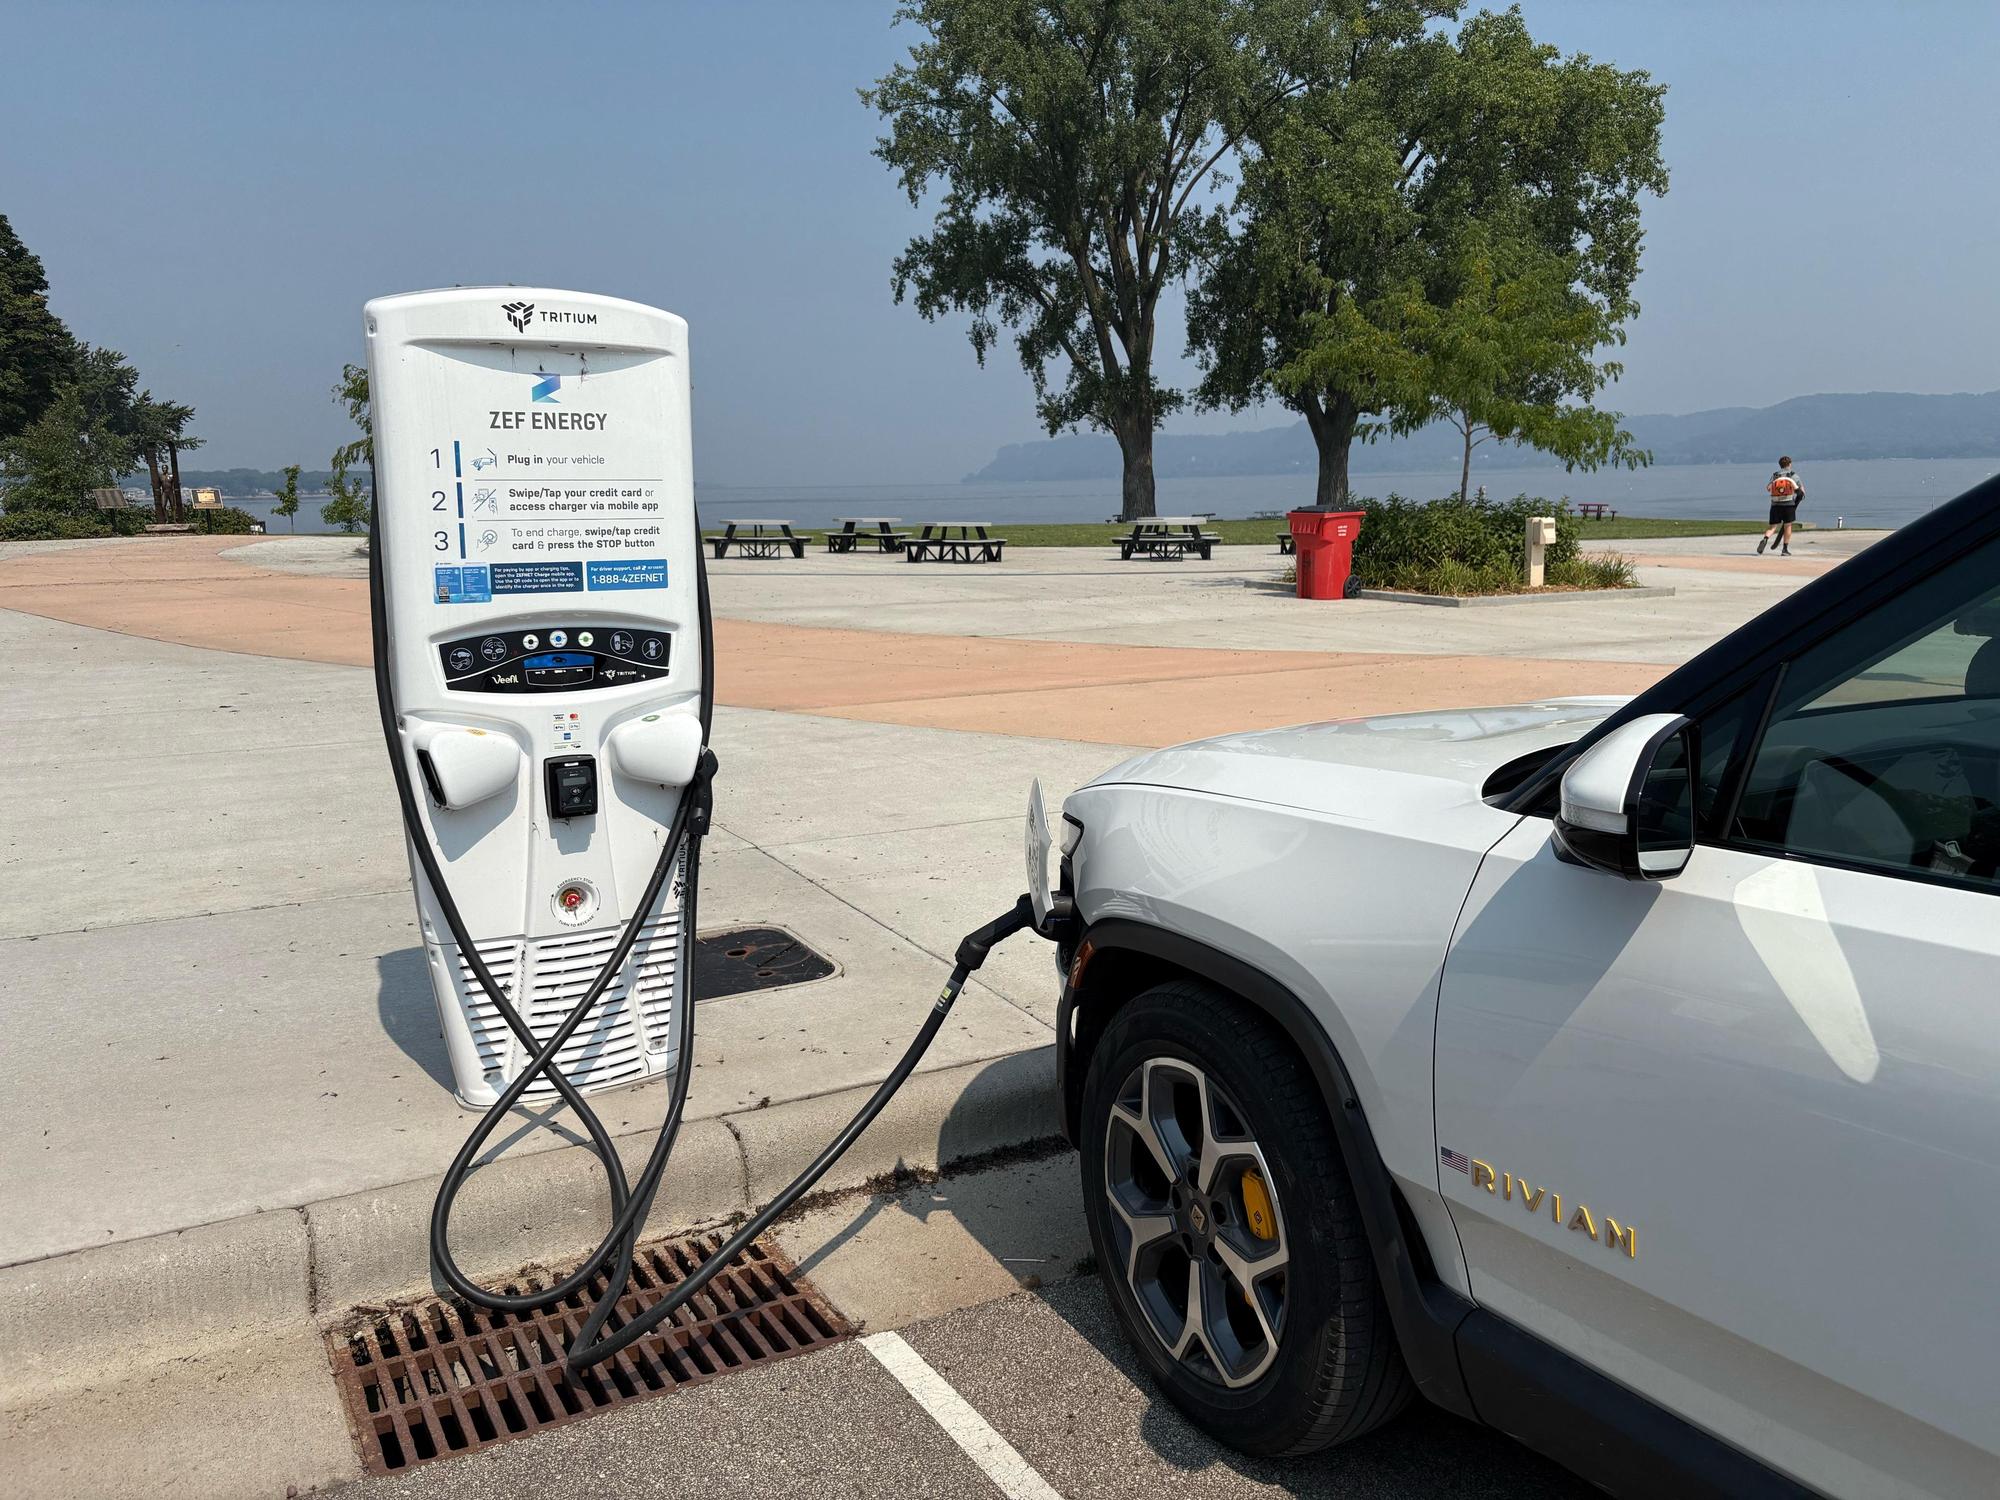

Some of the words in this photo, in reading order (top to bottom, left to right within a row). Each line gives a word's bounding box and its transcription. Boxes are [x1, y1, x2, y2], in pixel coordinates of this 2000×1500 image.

[540, 311, 597, 325] TRITIUM
[489, 411, 526, 429] ZEF
[531, 412, 608, 431] ENERGY
[430, 448, 440, 469] 1
[507, 454, 531, 466] Plug
[533, 454, 543, 464] in
[546, 456, 568, 466] your
[571, 454, 605, 464] vehicle
[431, 490, 447, 511] 2
[508, 487, 562, 500] Swipe/Tap
[564, 489, 587, 500] your
[589, 487, 618, 497] credit
[621, 487, 642, 497] card
[644, 489, 655, 497] or
[509, 503, 546, 511] access
[548, 501, 588, 512] charger
[590, 501, 605, 510] via
[607, 500, 639, 510] mobile
[641, 502, 659, 512] app
[511, 528, 523, 537] To
[526, 527, 544, 537] end
[546, 527, 582, 538] charge,
[585, 526, 631, 537] swipe/tap
[633, 525, 660, 535] credit
[434, 530, 449, 551] 3
[512, 541, 534, 550] card
[537, 540, 545, 549] &
[547, 541, 575, 551] press
[577, 540, 594, 548] the
[596, 539, 622, 548] STOP
[624, 538, 655, 548] button
[591, 573, 665, 584] 1-888-4ZEFNET
[679, 842, 687, 878] TRITIUM
[1471, 1159, 1636, 1260] RIVIAN
